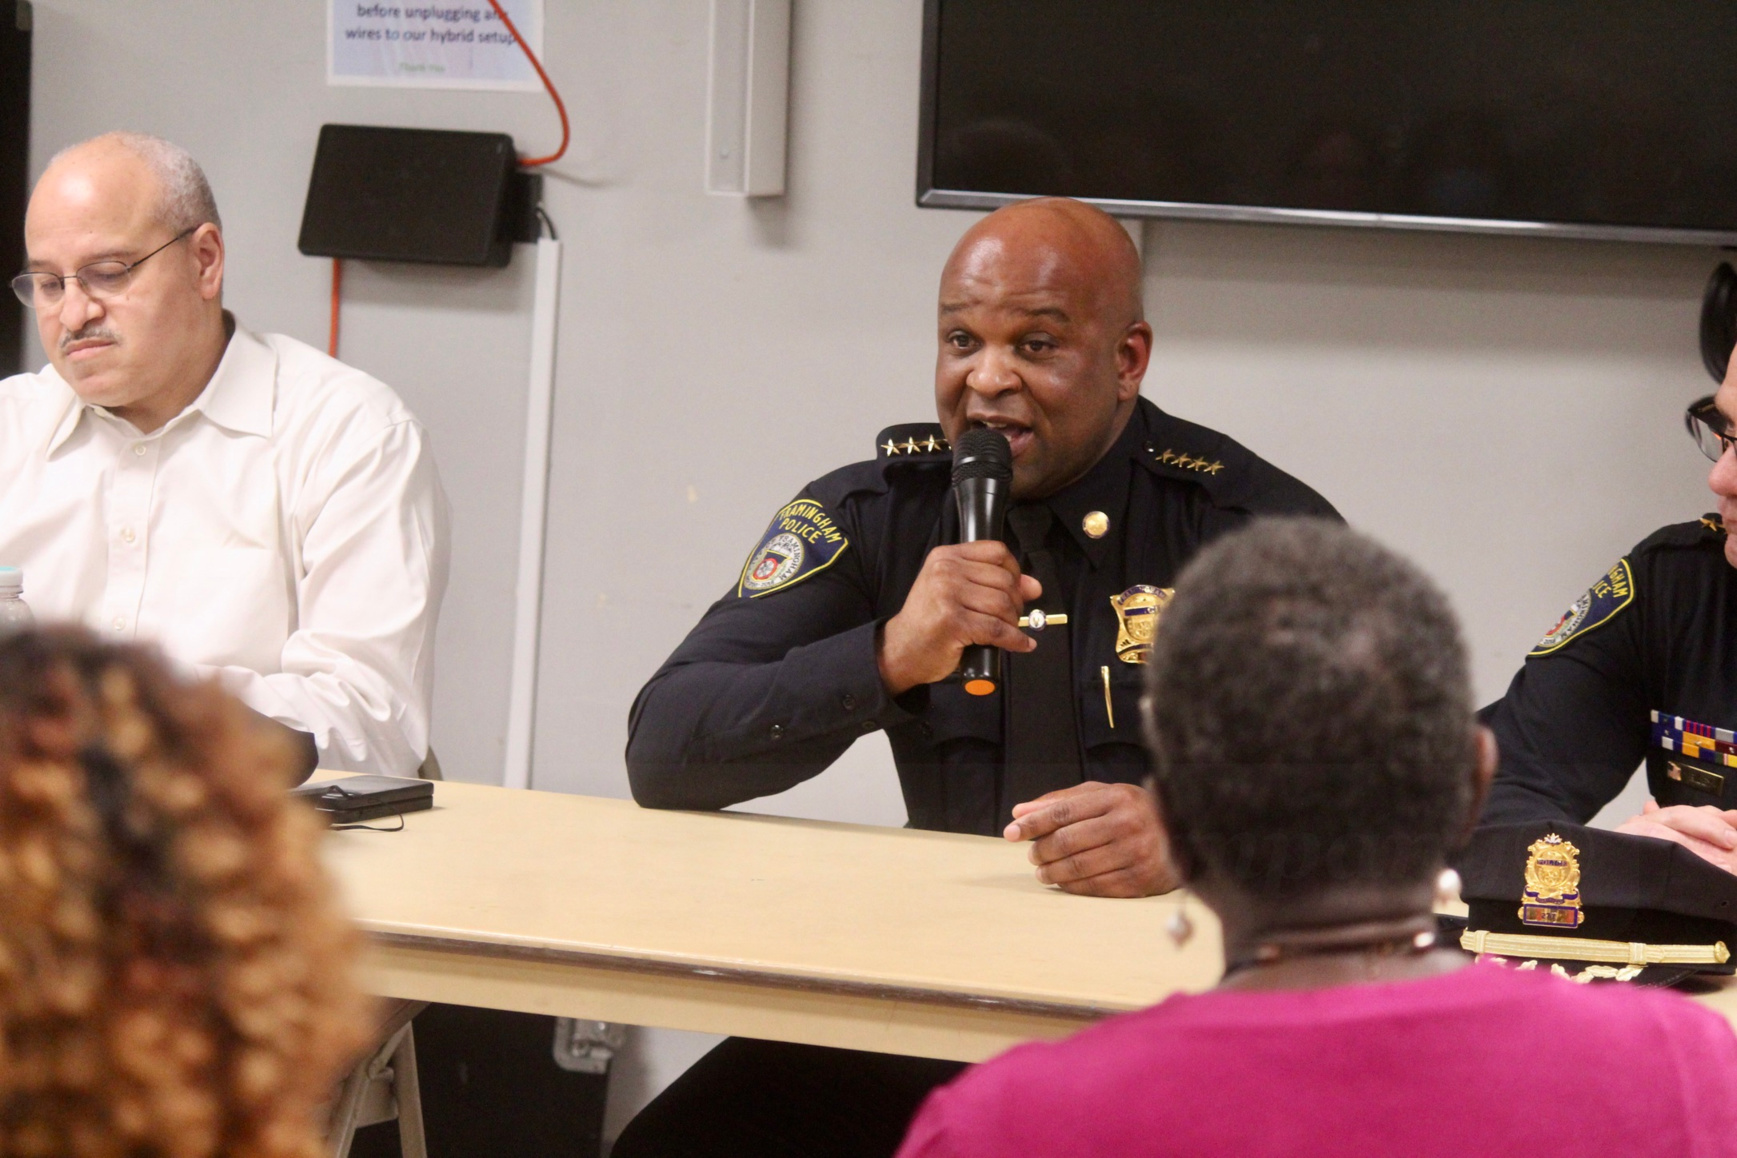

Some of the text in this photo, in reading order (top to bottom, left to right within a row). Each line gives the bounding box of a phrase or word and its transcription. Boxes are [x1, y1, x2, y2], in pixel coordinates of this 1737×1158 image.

[357, 4, 401, 18] before
[405, 5, 480, 22] unplugging
[345, 28, 382, 41] wires
[386, 29, 400, 41] to
[403, 31, 426, 42] our
[430, 29, 474, 45] hybrid
[778, 517, 822, 544] POLICE
